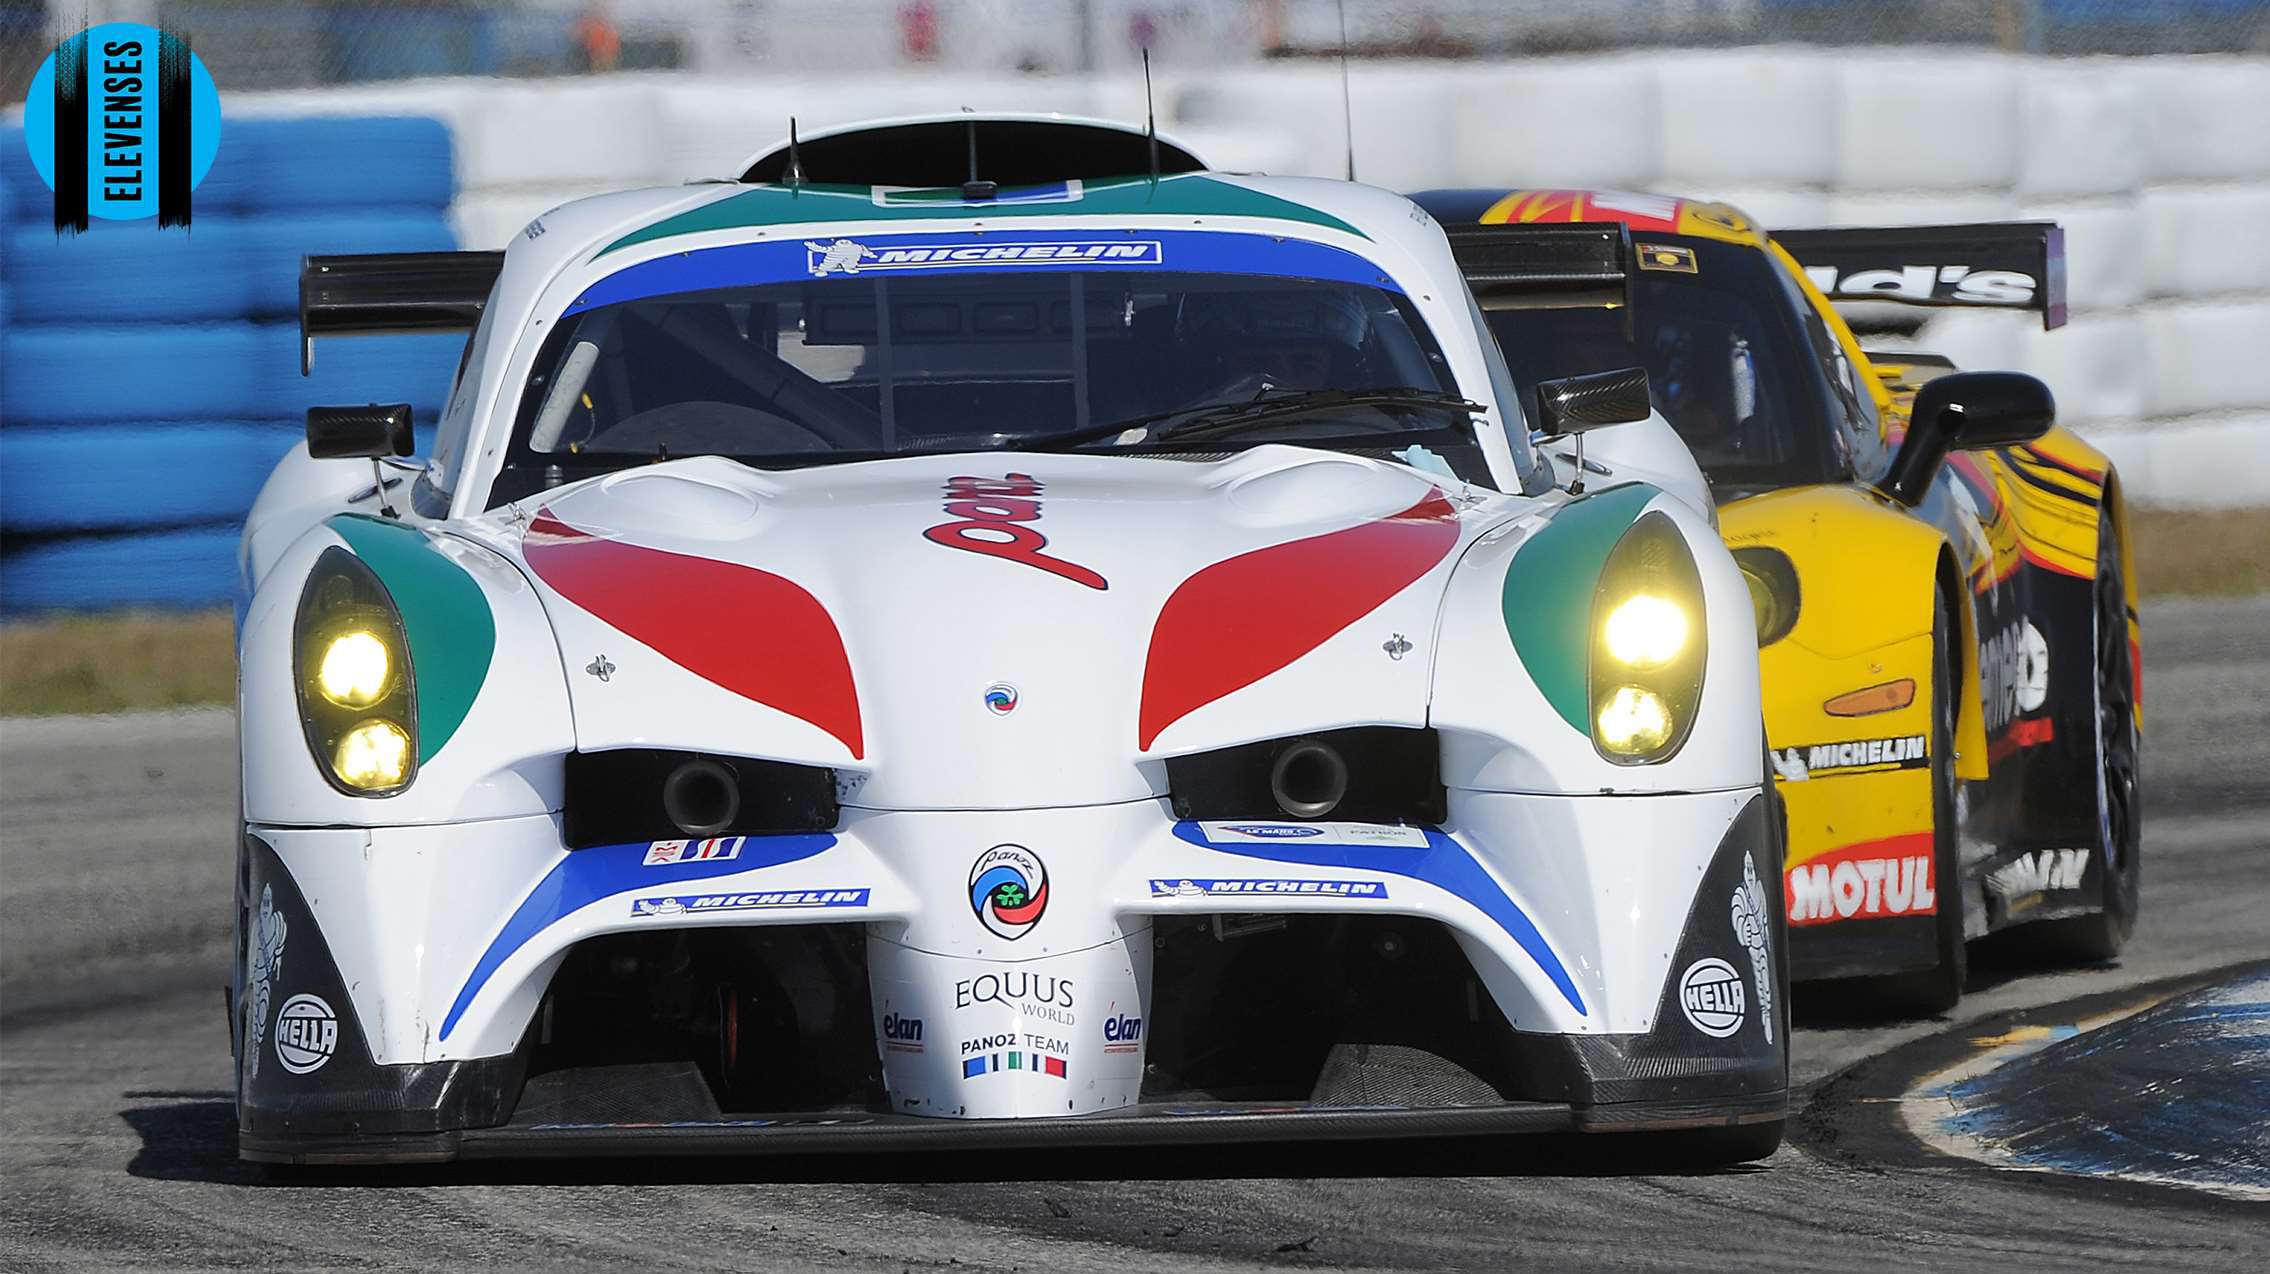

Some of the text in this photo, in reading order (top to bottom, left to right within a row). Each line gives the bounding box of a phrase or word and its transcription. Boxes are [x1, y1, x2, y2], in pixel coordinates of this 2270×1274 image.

[878, 244, 1149, 264] MICHELIN
[1808, 735, 1926, 770] MICHELIN
[692, 890, 861, 908] MICHELIN
[1210, 881, 1378, 895] MICHELIN
[1789, 855, 1935, 921] MOTUL
[954, 971, 1074, 1010] EQUUS
[1685, 979, 1745, 1014] HELLA
[883, 1012, 924, 1041] elan
[1021, 1002, 1076, 1027] WORLD
[1104, 1014, 1142, 1042] elan
[278, 1019, 339, 1055] HELLA
[1023, 1033, 1070, 1056] TEAM
